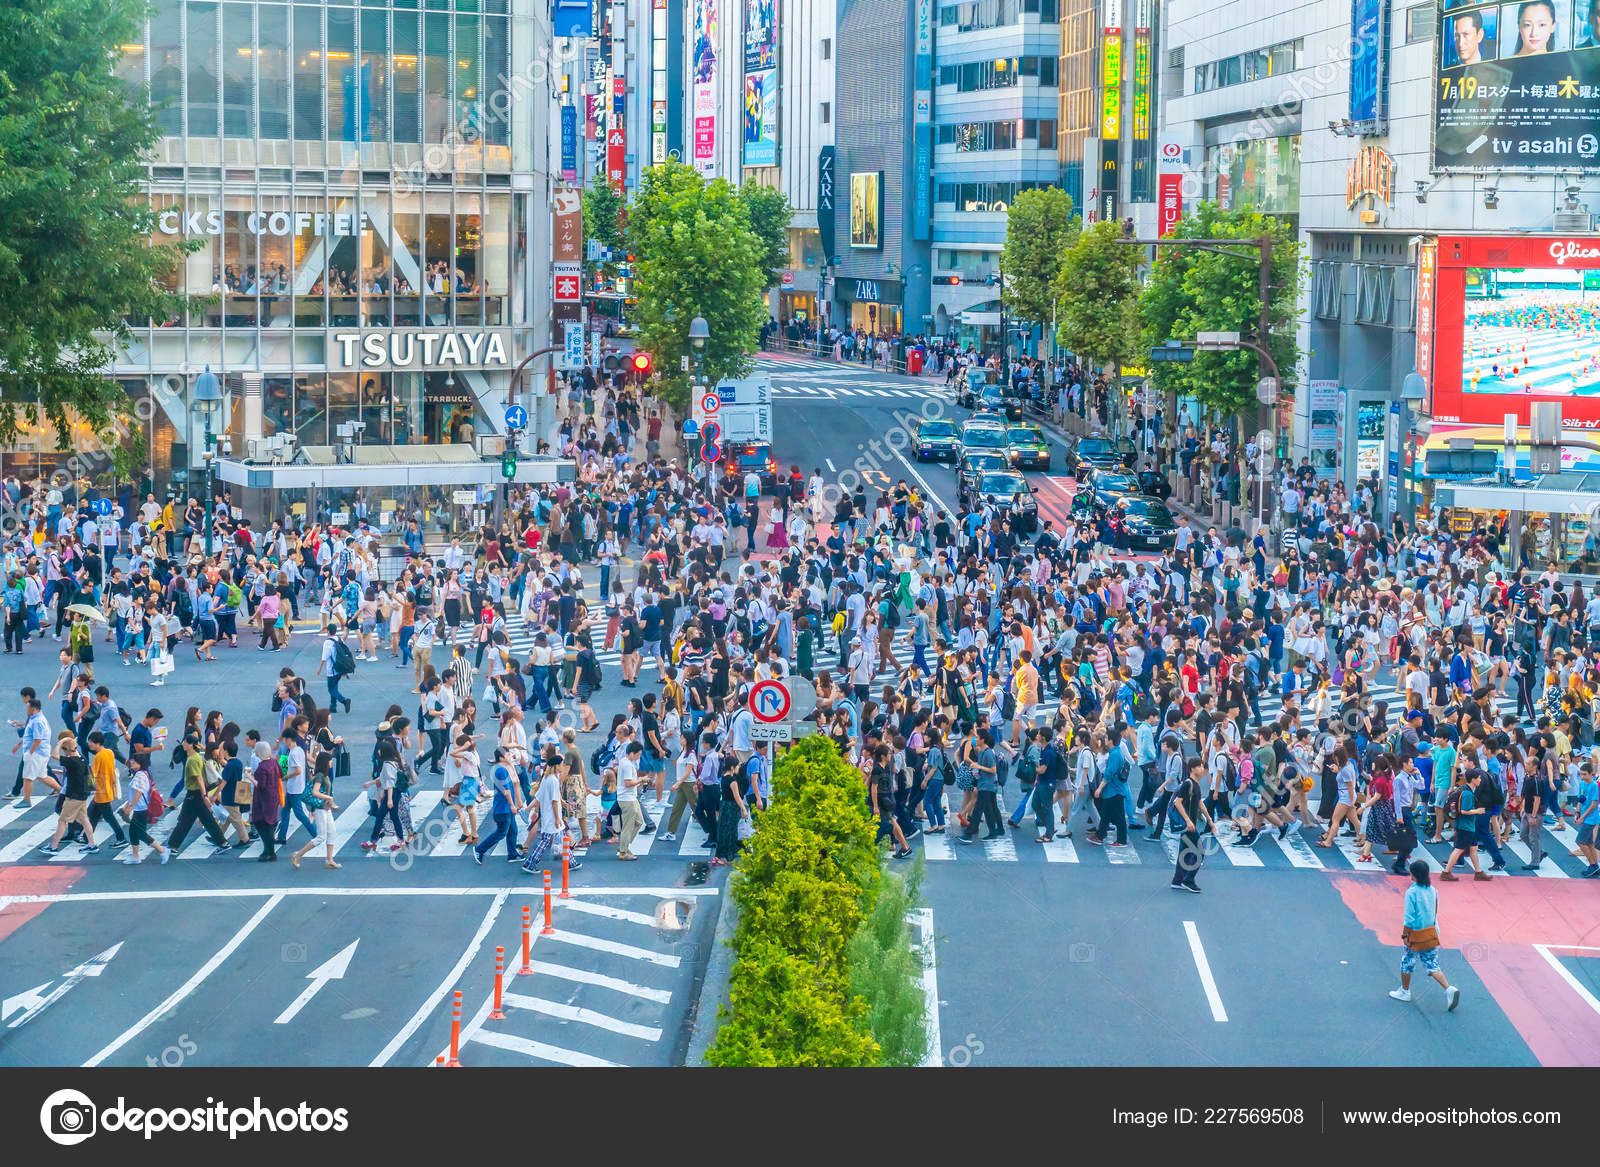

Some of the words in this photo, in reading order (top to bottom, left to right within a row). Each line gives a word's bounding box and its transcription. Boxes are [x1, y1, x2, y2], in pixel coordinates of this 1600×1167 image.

[1492, 138, 1512, 153] tv
[1519, 137, 1572, 153] asahi
[820, 157, 832, 210] ZARA
[248, 211, 368, 236] COFFEE
[1549, 241, 1600, 265] Glico
[558, 278, 577, 297] 本
[855, 280, 880, 300] ZARA
[336, 332, 509, 368] TSUTAYA
[573, 326, 581, 366] 渋谷駅前
[758, 386, 767, 403] VAN
[759, 407, 768, 436] LINES
[751, 728, 788, 739] ここから
